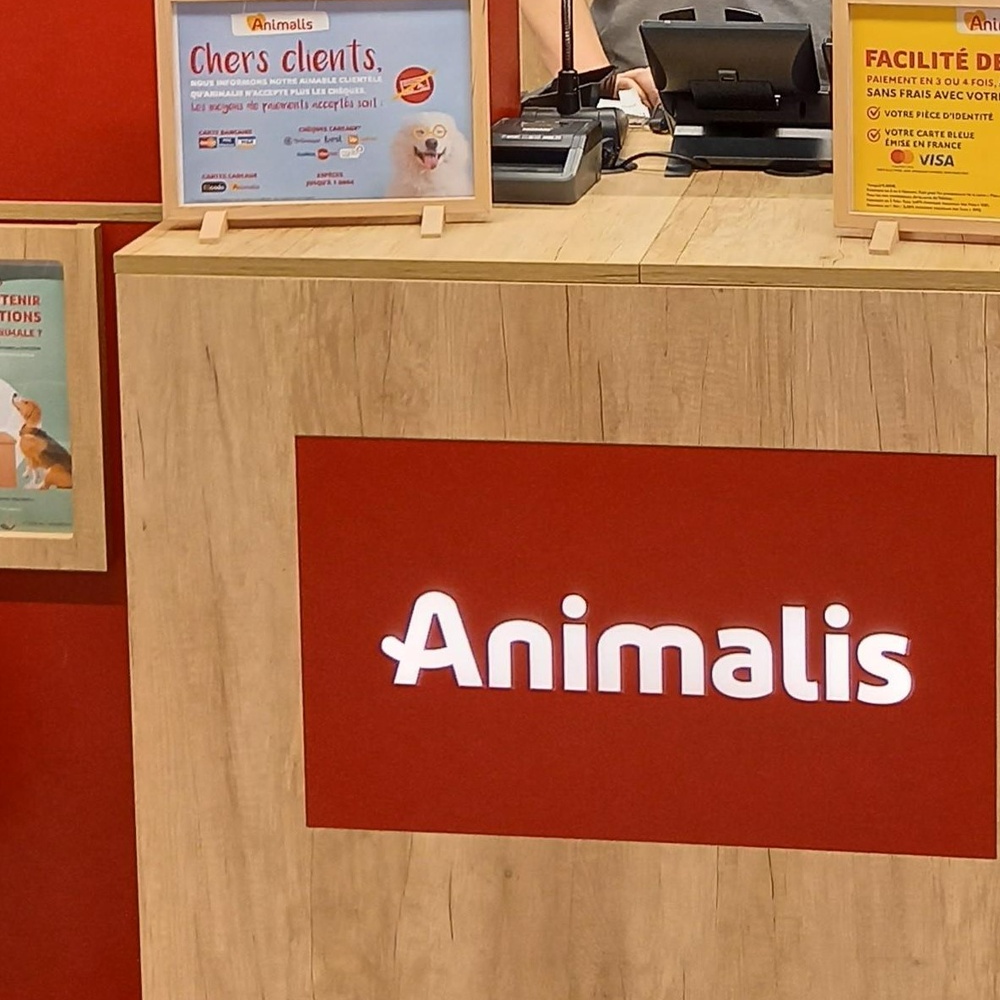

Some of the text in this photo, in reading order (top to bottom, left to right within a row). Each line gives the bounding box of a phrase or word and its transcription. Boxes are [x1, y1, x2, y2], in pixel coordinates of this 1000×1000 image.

[251, 17, 313, 32] Animalis
[190, 39, 382, 75] Chers clients,
[865, 48, 968, 70] FACILITÉ
[867, 75, 917, 85] PAIEMENT
[920, 77, 933, 85] EN
[944, 78, 960, 86] OU
[971, 78, 997, 88] FOIS,
[867, 88, 897, 98] SANS
[900, 89, 931, 99] FRAIS
[934, 90, 963, 100] AVEC
[884, 110, 994, 121] VOTRE PIÈCE D'IDENTITÉ
[885, 128, 975, 139] VOTRE CARTE BLEUE
[885, 138, 962, 149] ÉMISE EN FRANCE
[920, 154, 955, 167] VISA
[380, 590, 913, 705] Animalis
